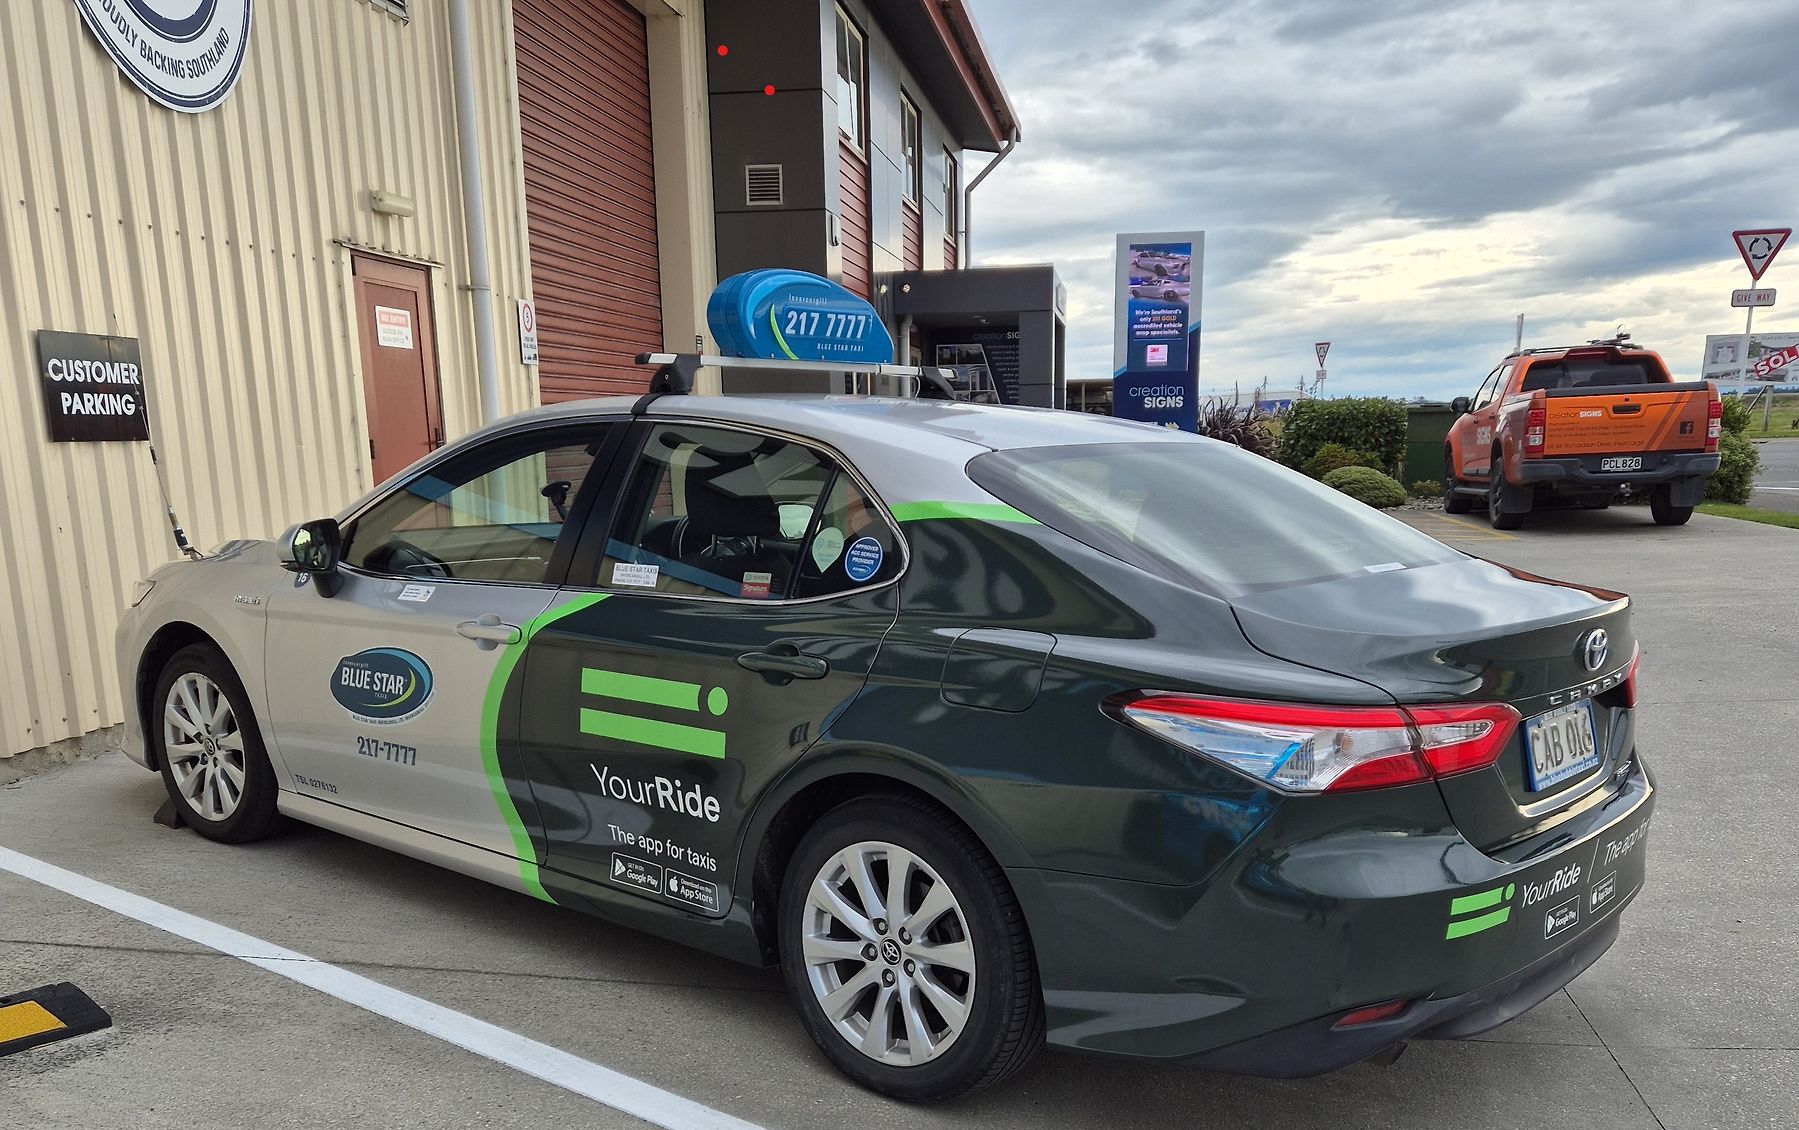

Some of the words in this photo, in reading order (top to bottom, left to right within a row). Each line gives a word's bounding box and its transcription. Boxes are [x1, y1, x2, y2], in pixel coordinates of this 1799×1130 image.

[101, 0, 138, 48] OUDLY
[139, 38, 186, 79] BACKING
[186, 26, 230, 79] SOUTHLAND
[1736, 294, 1752, 303] GIVE
[1756, 293, 1771, 302] WAY
[785, 310, 820, 336] 217
[825, 313, 866, 339] 7777
[1006, 331, 1019, 339] SIG
[816, 342, 832, 350] BLUE
[833, 343, 848, 351] STAR
[48, 358, 140, 385] CUSTOMER
[1756, 345, 1799, 375] SOL
[1129, 383, 1184, 398] creation
[1144, 396, 1184, 409] SIGNS
[60, 392, 136, 416] PARKING
[297, 572, 309, 583] 16
[616, 564, 628, 572] BLUE
[341, 666, 372, 690] BLUE
[373, 671, 404, 695] STAR
[1549, 672, 1622, 705] CAMRY
[356, 736, 417, 767] 217-7777
[1531, 722, 1564, 774] CAB
[1565, 713, 1593, 759] 016
[295, 774, 309, 786] TSL
[590, 763, 721, 823] YourRide
[607, 824, 635, 846] The
[638, 834, 663, 856] app
[665, 839, 685, 861] for
[687, 847, 717, 872] taxis
[1603, 840, 1622, 866] The
[626, 869, 647, 884] Google
[647, 875, 659, 888] Play
[1521, 862, 1581, 908] YourRide
[680, 885, 695, 900] App
[694, 889, 713, 904] Store
